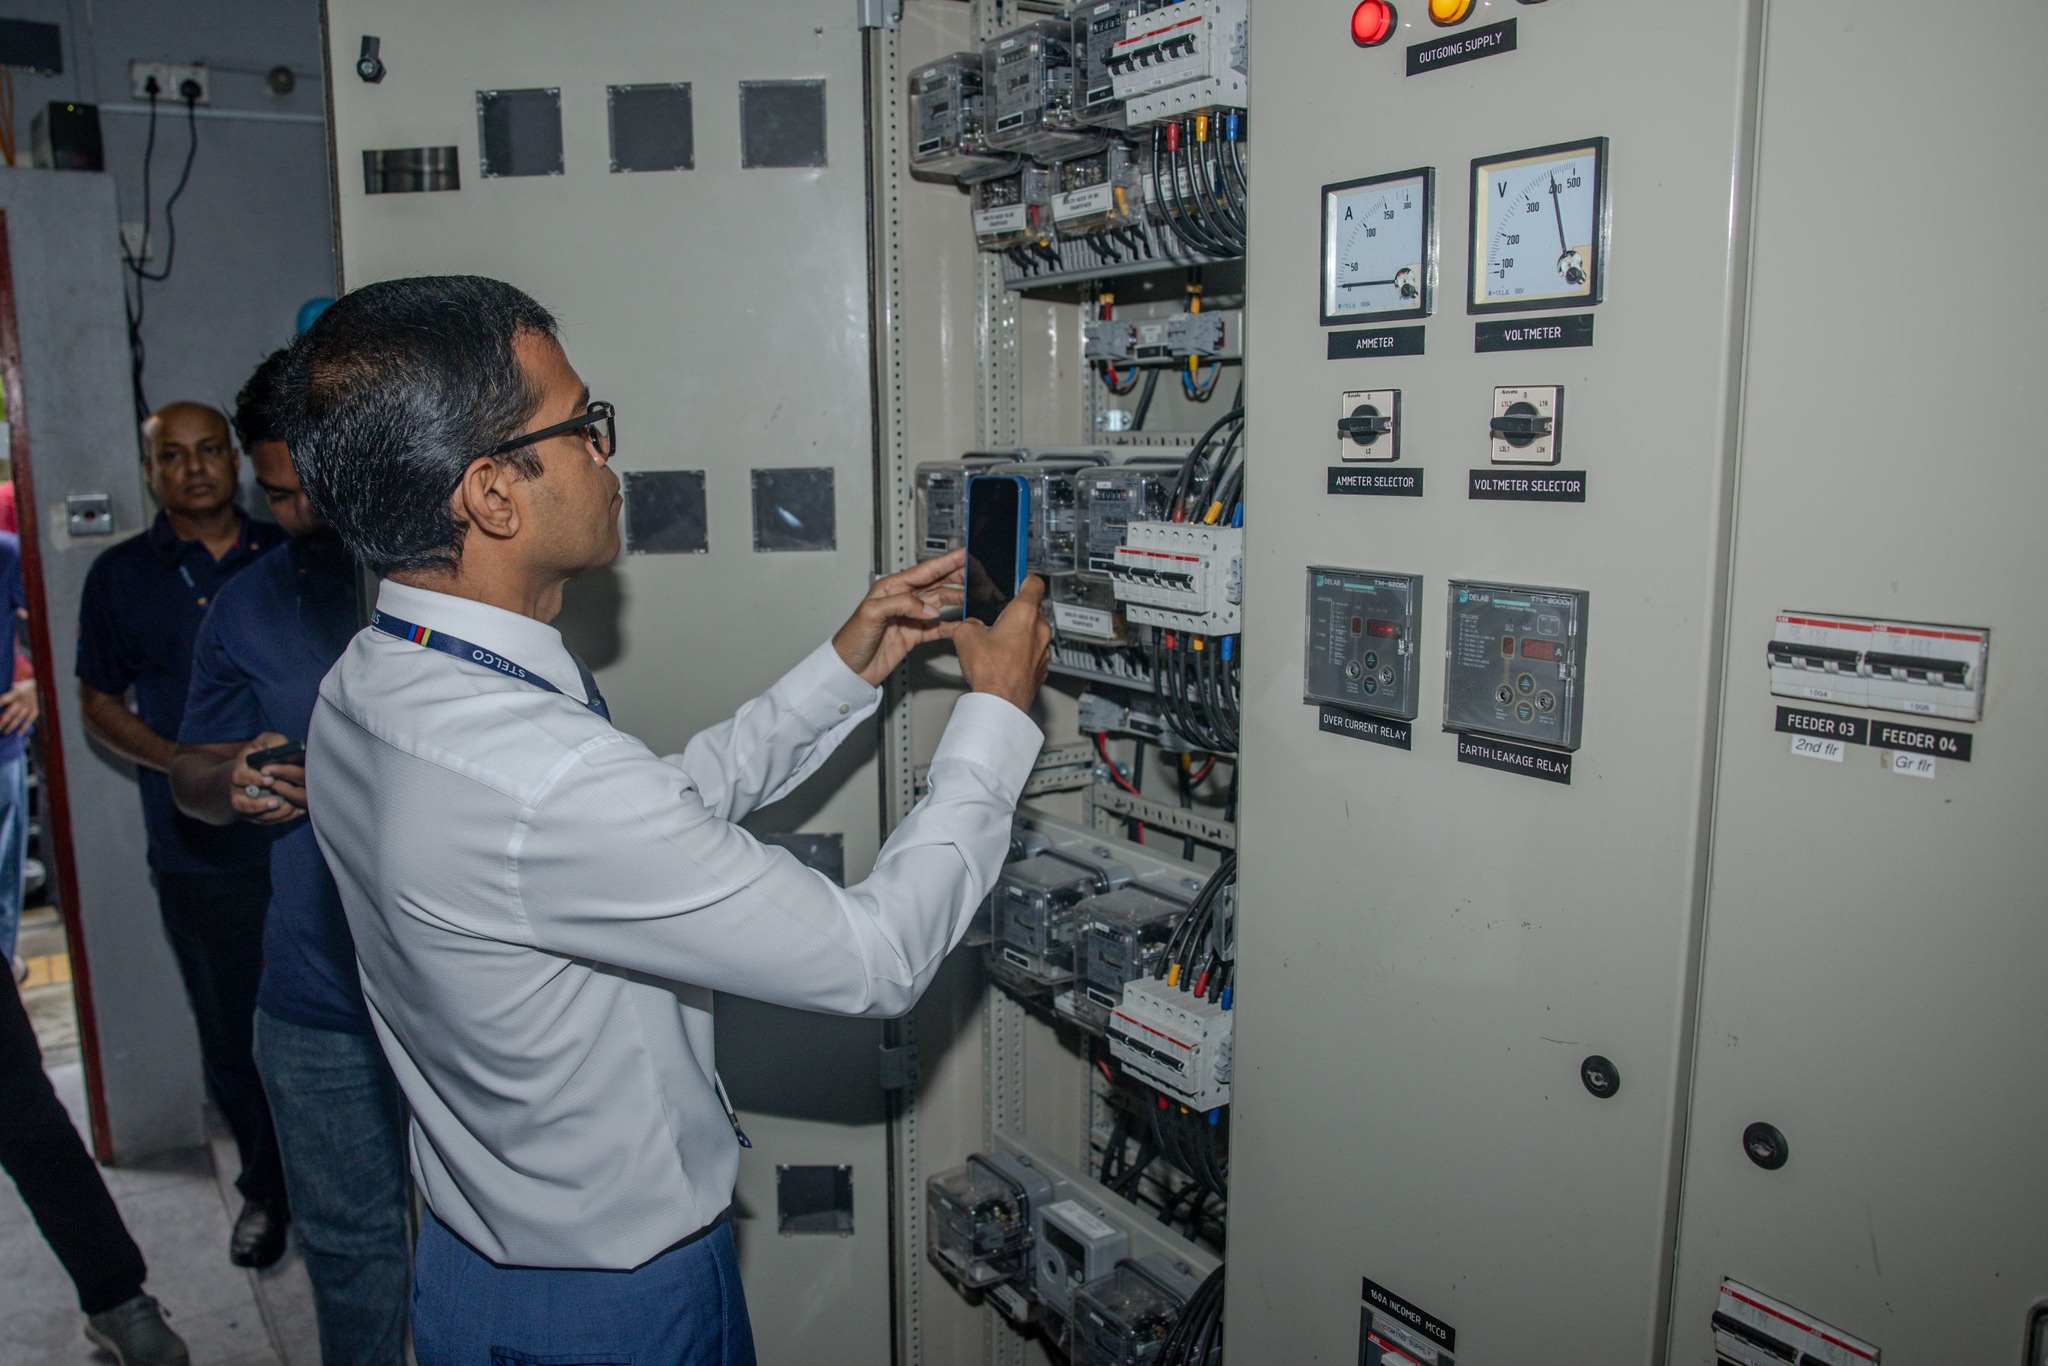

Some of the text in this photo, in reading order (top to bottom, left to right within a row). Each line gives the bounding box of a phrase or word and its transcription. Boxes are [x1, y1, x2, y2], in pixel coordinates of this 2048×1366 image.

[1419, 32, 1502, 64] OUTGOING SUPPLY
[1567, 177, 1581, 188] 500
[1498, 182, 1507, 198] V
[1345, 206, 1353, 220] A
[1526, 202, 1539, 213] 300
[1384, 210, 1394, 220] 150
[1366, 228, 1376, 237] 100
[1507, 234, 1520, 245] 200
[1351, 262, 1358, 271] 50
[1502, 258, 1513, 268] 100
[1500, 270, 1505, 278] 0
[1504, 326, 1562, 341] VOLTMETER
[1356, 337, 1394, 349] AMMETER
[1336, 476, 1414, 487] AMMETER SELECTOR
[1475, 479, 1580, 492] VOLTMETER SELECTOR
[1469, 594, 1489, 602] DELAB
[473, 650, 525, 678] STELCO
[1324, 713, 1407, 741] OVER CURRENT RELAY
[1788, 714, 1855, 736] FEEDER 03
[1882, 728, 1957, 752] FEEDER 04
[1796, 738, 1839, 756] 2nd flr
[1460, 743, 1569, 775] EARTH LEAKAGE RELAY
[1895, 755, 1933, 772] Gr flr
[1370, 1289, 1446, 1340] 160A INCOMER MCCB
